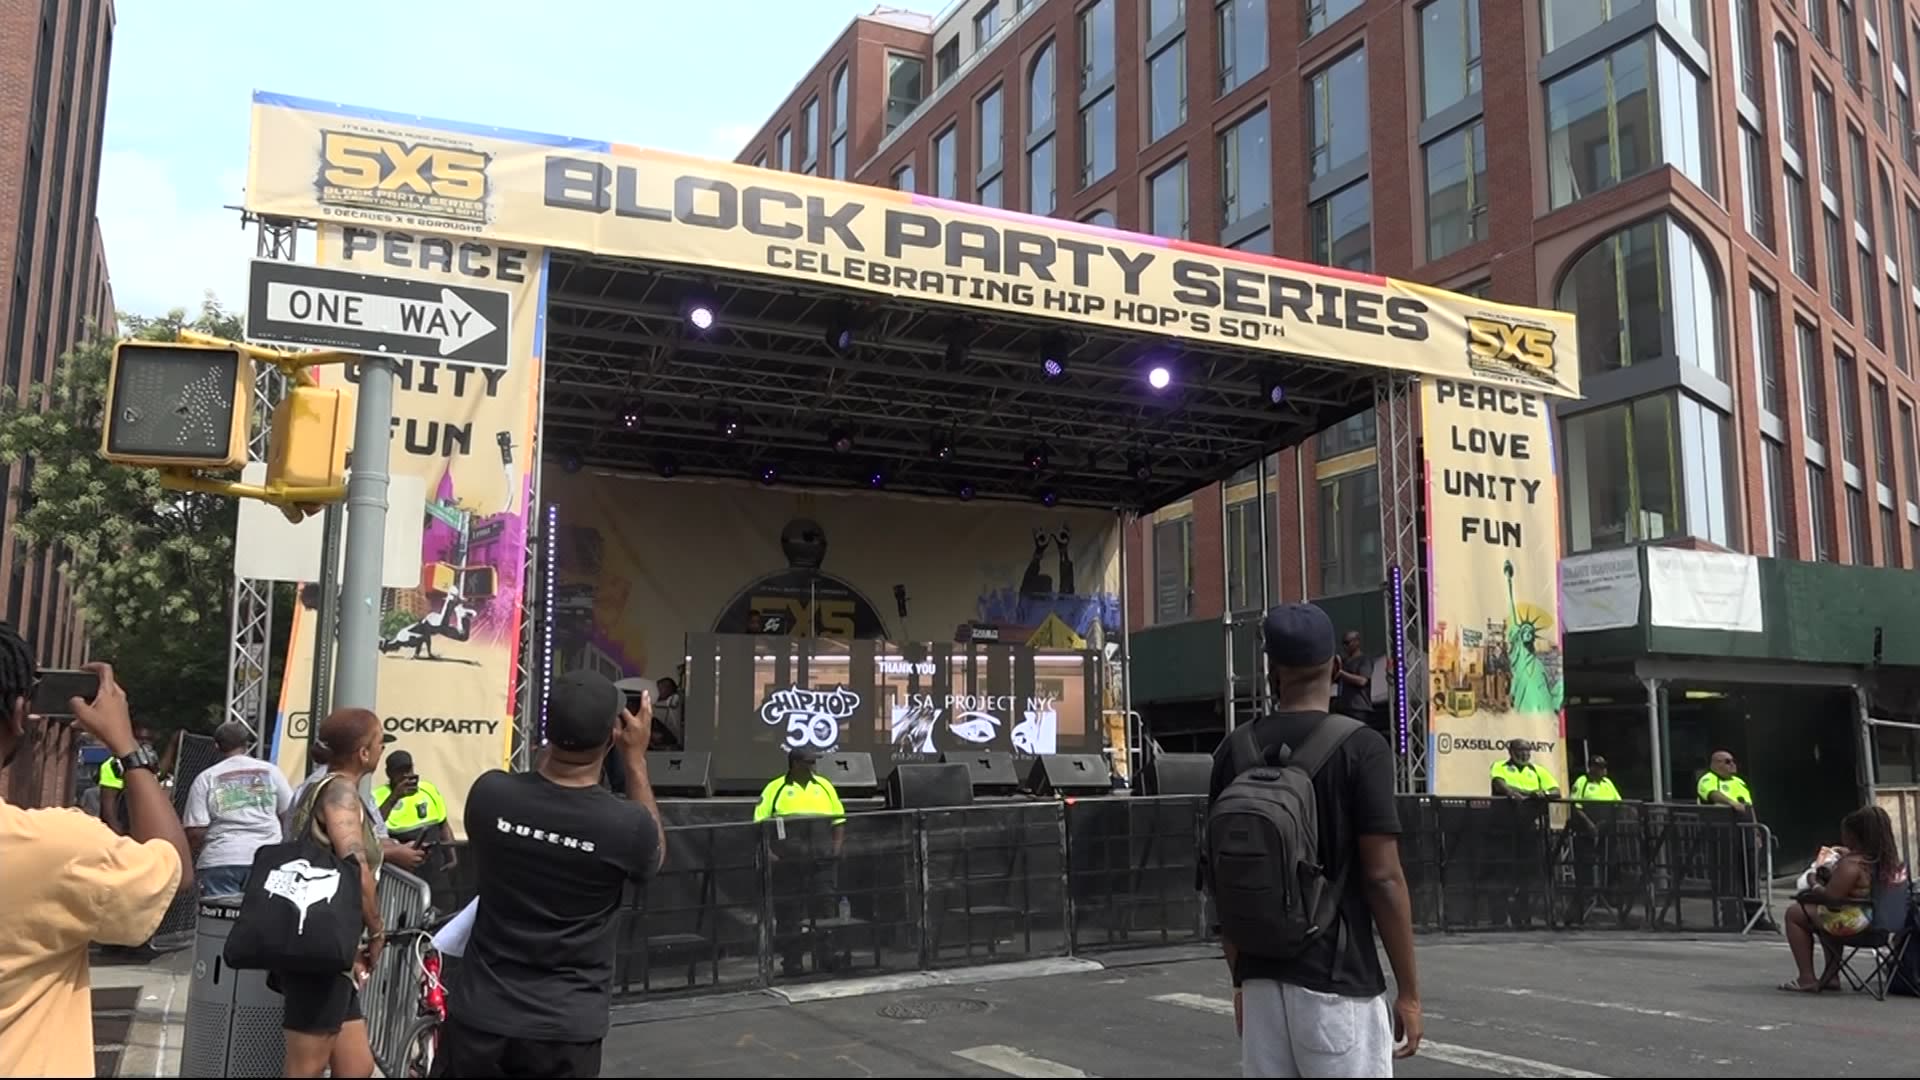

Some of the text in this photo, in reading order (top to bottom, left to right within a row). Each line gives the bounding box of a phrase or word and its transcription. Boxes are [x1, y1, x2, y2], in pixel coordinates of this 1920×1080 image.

[323, 186, 484, 210] BLOCK PARTY SERIES
[334, 210, 394, 222] DECADES
[418, 219, 483, 232] BOROUGHS
[343, 227, 528, 283] PEACE
[545, 155, 1430, 342] BLOCK PARTY SERIES
[767, 245, 1285, 341] CELEBRATING HIP HOP'S 50TH
[289, 290, 472, 338] ONE WAY
[1436, 379, 1538, 418] PEACE
[390, 417, 473, 457] UN
[1451, 425, 1530, 460] LOVE
[1444, 469, 1541, 504] UNITY
[1462, 517, 1522, 548] FUN
[879, 662, 936, 676] THANK YOU
[945, 695, 1016, 711] PROJECT
[1027, 697, 1057, 711] NYC
[383, 717, 499, 735] OCKPARTY
[785, 713, 838, 747] 50
